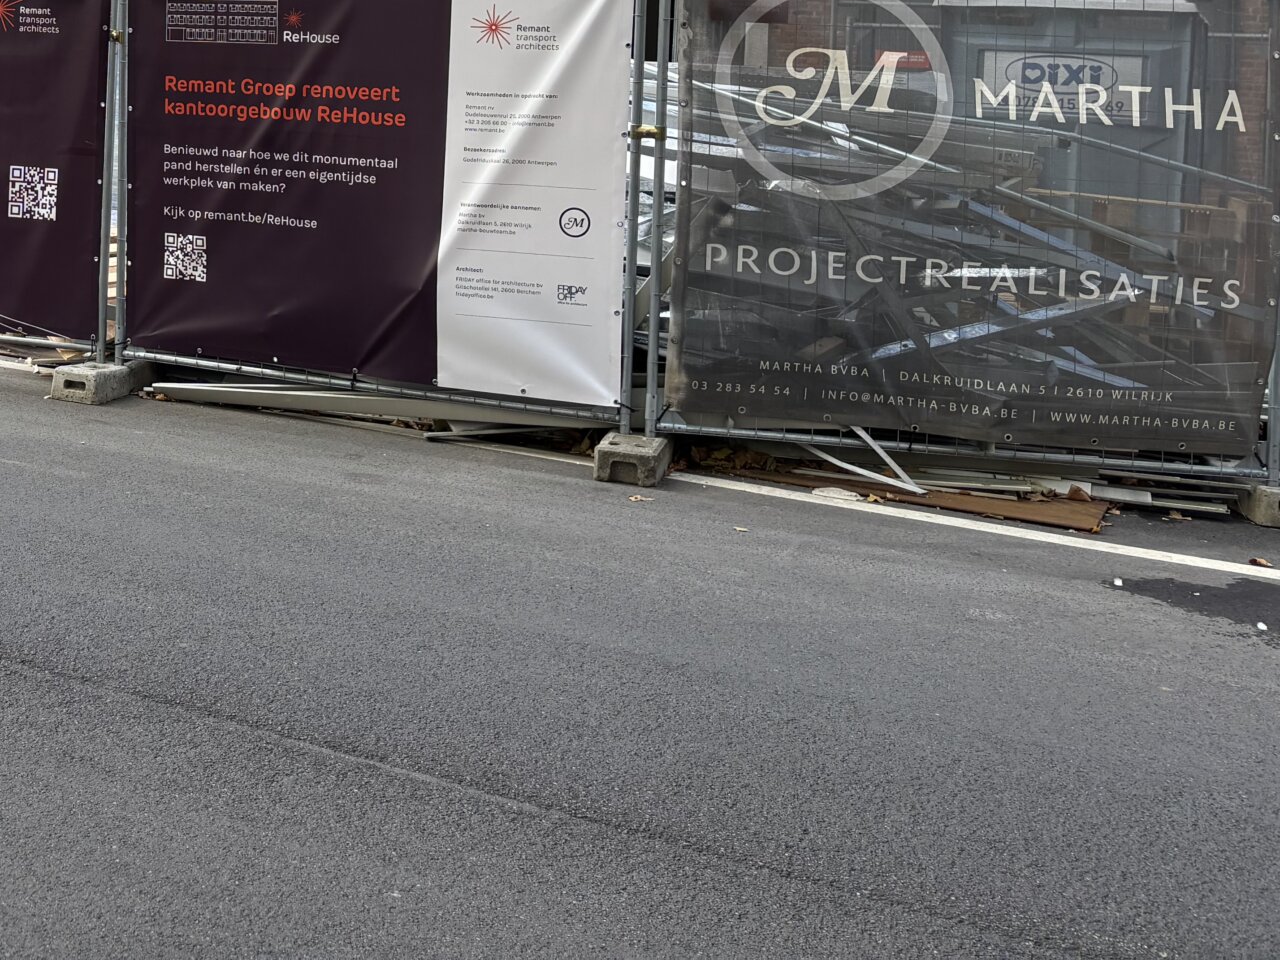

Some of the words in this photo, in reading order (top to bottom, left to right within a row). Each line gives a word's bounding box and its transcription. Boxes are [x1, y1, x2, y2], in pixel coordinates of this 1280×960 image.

[19, 6, 51, 15] Remant
[19, 16, 57, 26] transport
[19, 24, 60, 34] architects
[516, 24, 550, 33] Remant
[283, 31, 340, 44] ReHouse
[516, 34, 557, 43] transport
[516, 42, 560, 51] architects
[164, 76, 235, 94] Remant
[241, 78, 296, 100] Groep
[302, 83, 400, 102] renoveert
[164, 98, 312, 122] kantoorgebouw
[317, 105, 406, 126] ReHouse
[973, 78, 1247, 133] MARTHA
[164, 144, 219, 157] Benieuwd
[222, 147, 247, 160] naar
[249, 148, 271, 161] hoe
[274, 152, 290, 163] we
[292, 151, 309, 163] dit
[312, 154, 398, 169] monumentaal
[163, 160, 192, 173] pand
[195, 160, 250, 175] herstellen
[254, 163, 268, 176] én
[271, 167, 283, 177] er
[285, 168, 306, 179] een
[309, 168, 377, 186] eigentijdse
[163, 175, 214, 189] werkplek
[217, 179, 236, 191] van
[239, 179, 286, 193] maken?
[163, 206, 185, 219] Kijk
[188, 208, 202, 221] op
[204, 209, 318, 229] remant.be/ReHouse
[705, 243, 1242, 310] PROJECTREALISATIES
[558, 285, 588, 295] FRIDAY
[759, 360, 822, 374] MARTHA
[831, 365, 869, 377] BVBA
[899, 371, 1030, 394] DALKRUIDLAAN
[1038, 385, 1045, 395] 5
[1066, 386, 1104, 399] 2610
[1111, 390, 1173, 402] WILRIJK
[691, 380, 708, 391] 03
[716, 382, 741, 393] 283
[749, 384, 765, 395] 54
[773, 385, 790, 396] 54
[821, 389, 1018, 419] INFO@MARTHA-BVBA.BE
[1050, 411, 1236, 431] WWW.MARTHA-BVBA.BE
